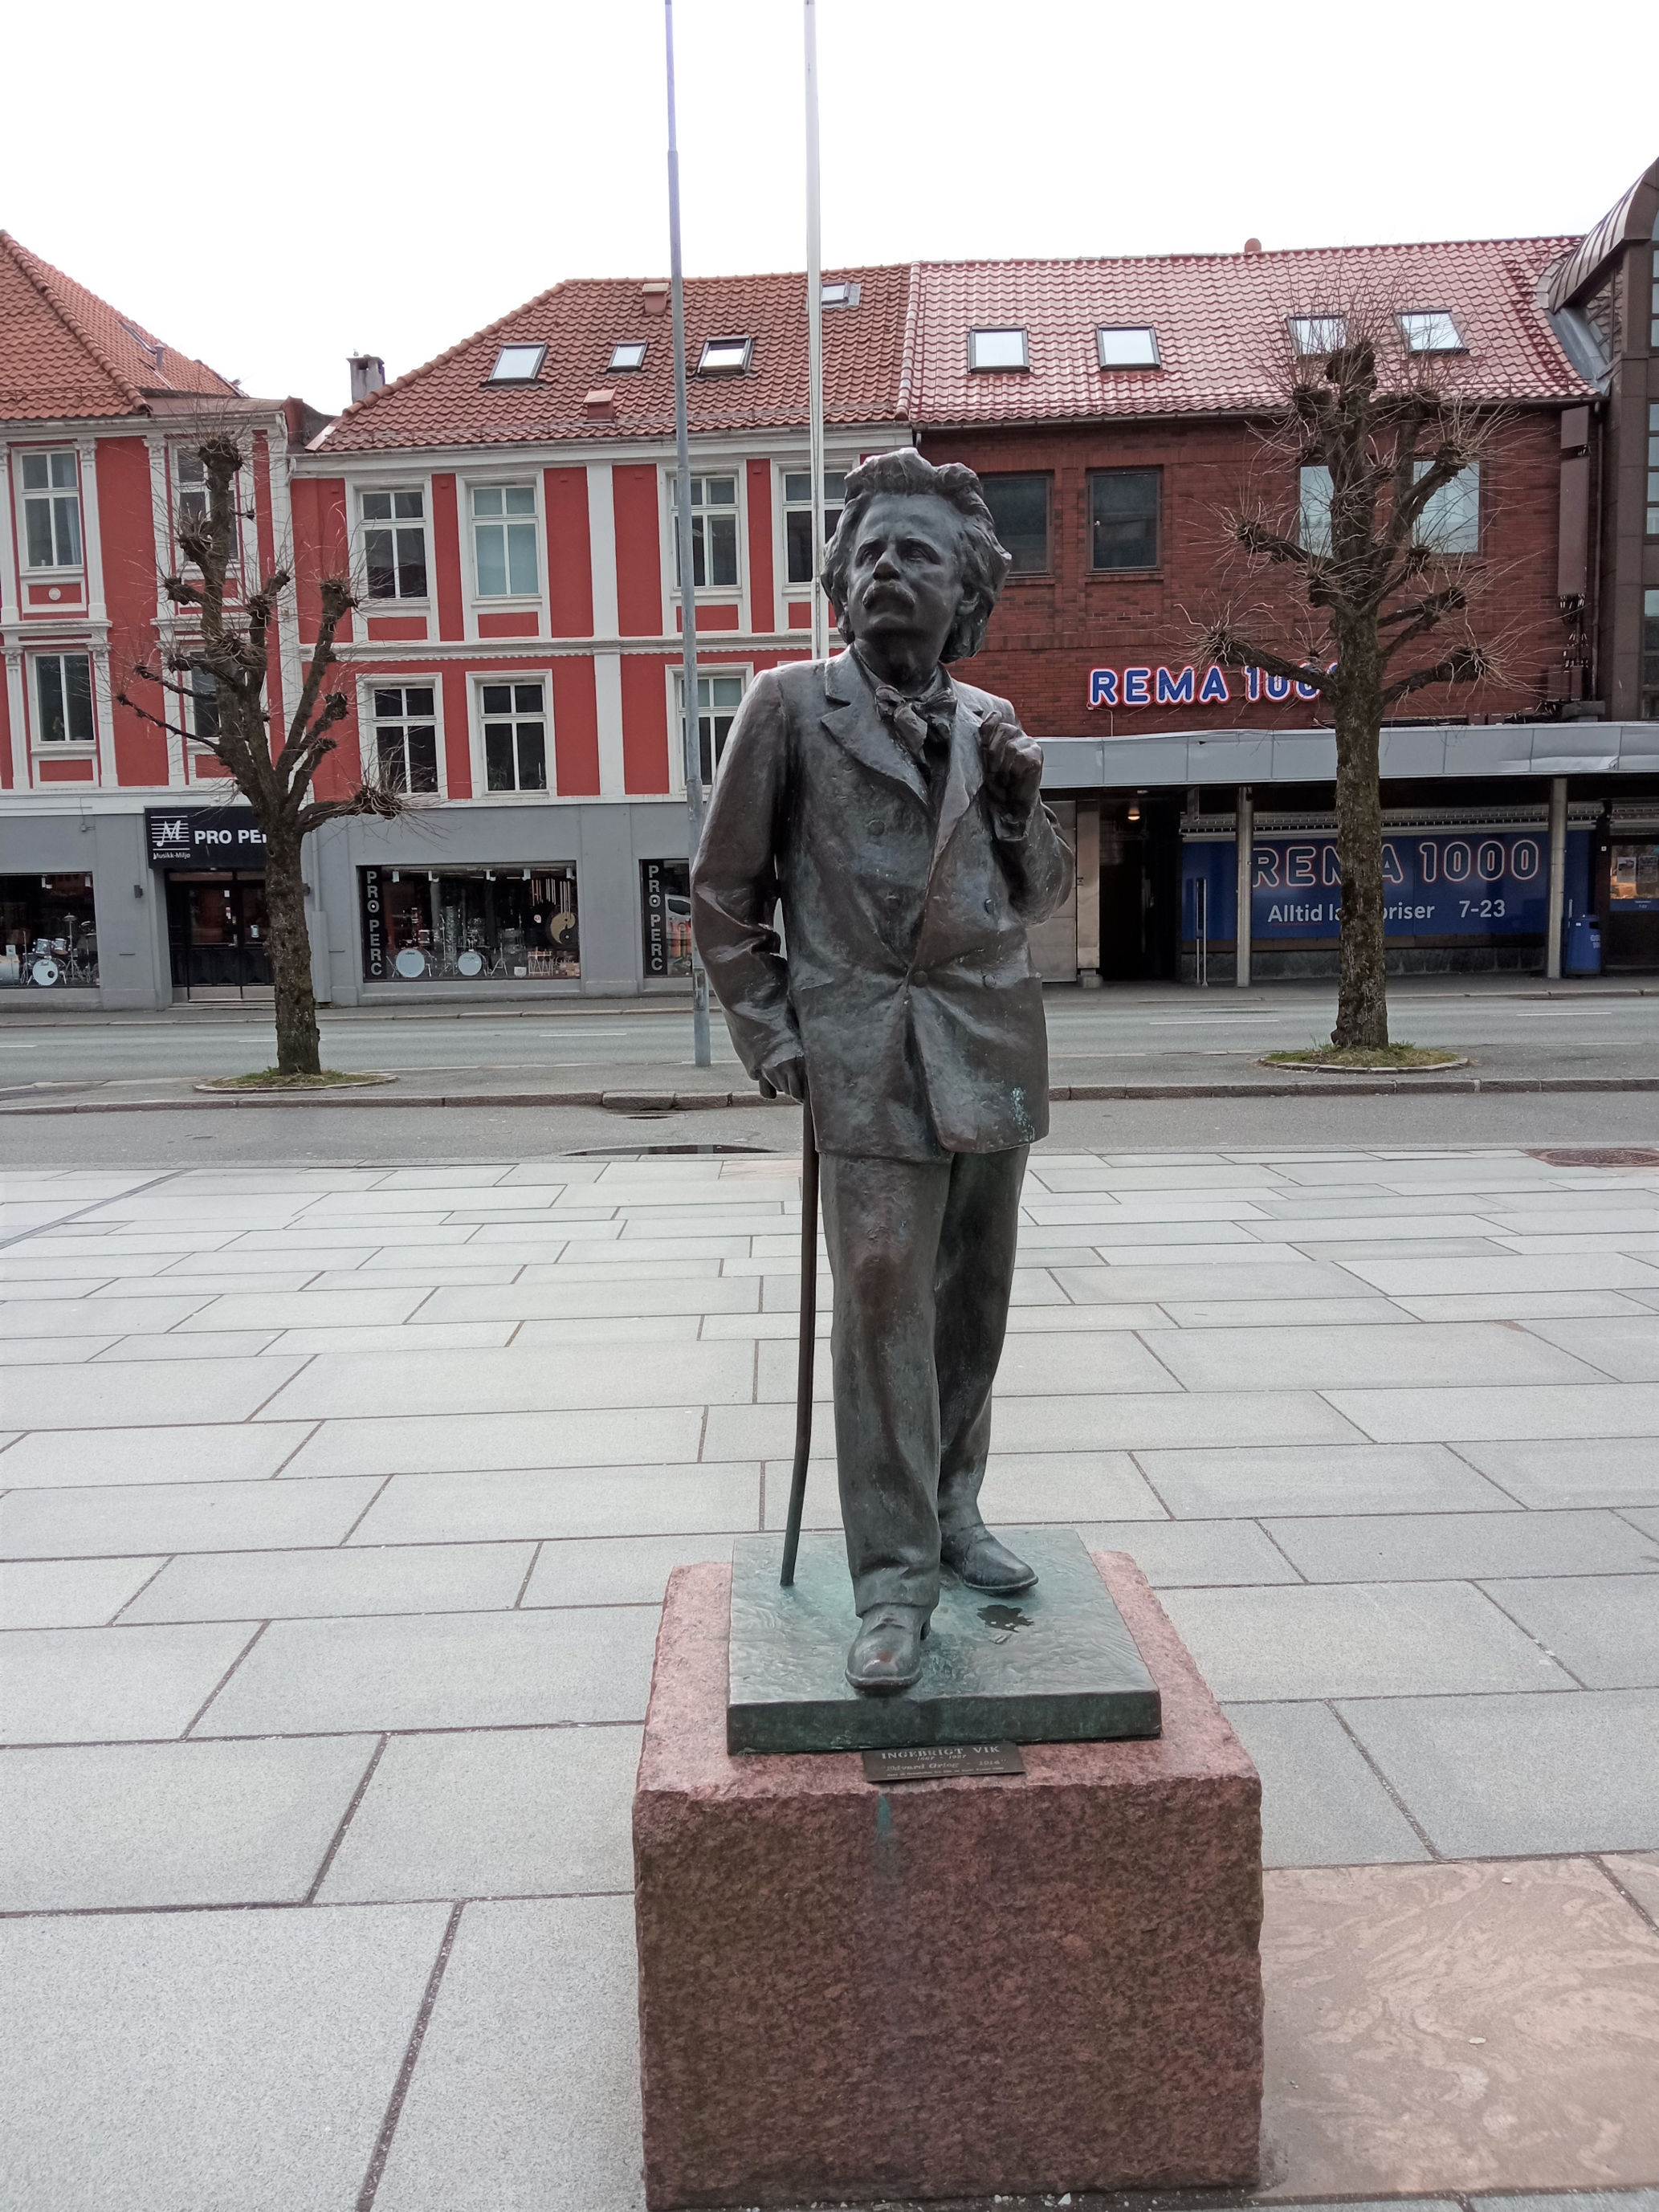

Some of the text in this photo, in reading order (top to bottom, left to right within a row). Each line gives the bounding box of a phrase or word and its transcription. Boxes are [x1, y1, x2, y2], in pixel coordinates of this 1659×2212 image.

[1088, 662, 1339, 707] REMA 100
[194, 829, 267, 844] PRO PE
[1419, 839, 1539, 883] 1000
[366, 871, 382, 976] PRO PERC
[648, 866, 663, 971] PRO PERC
[1267, 904, 1322, 923] Alltid
[1459, 899, 1506, 919] 7-23
[882, 1748, 963, 1759] INGEBRIGT
